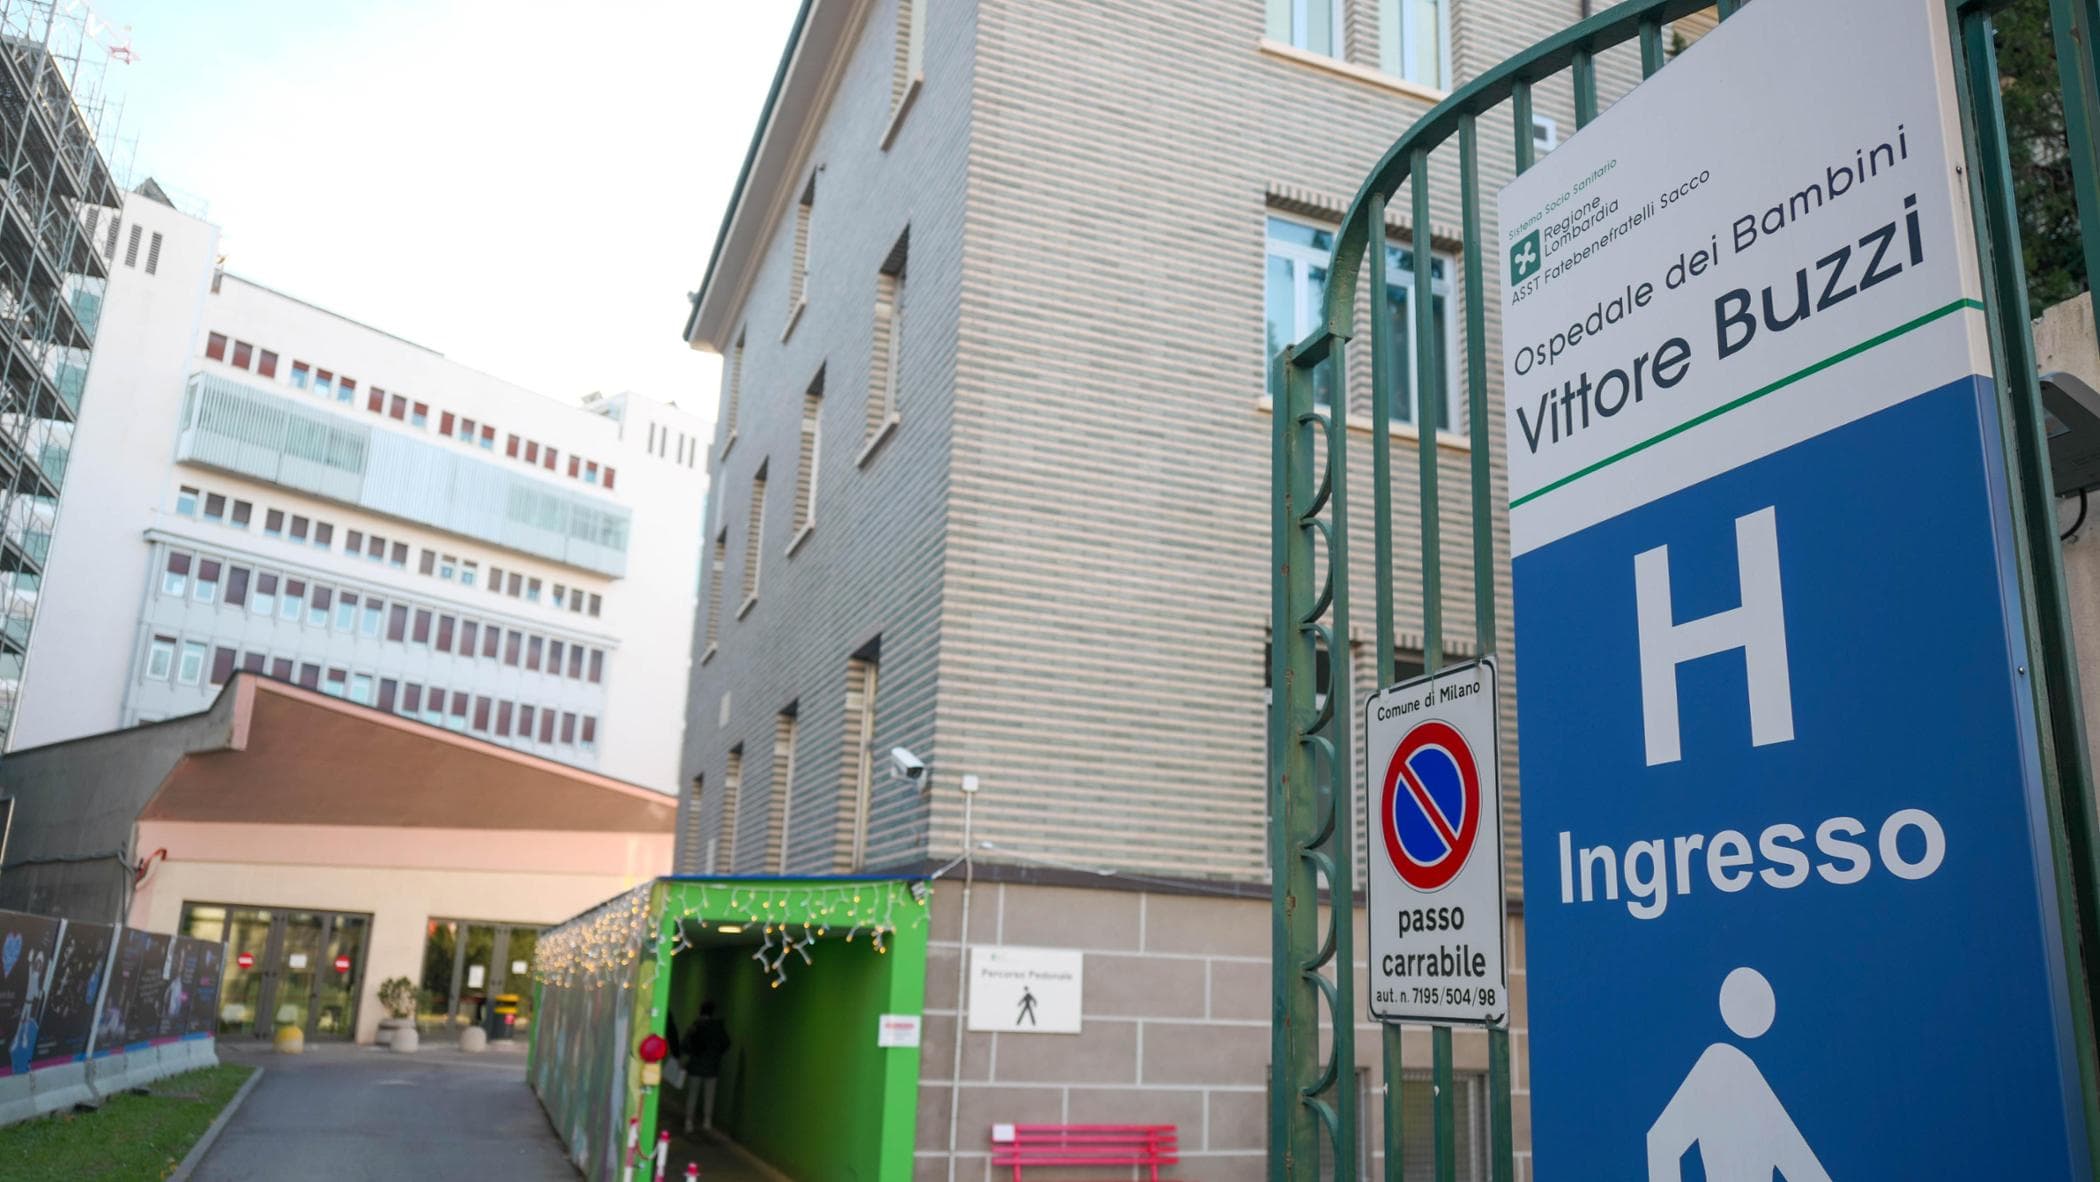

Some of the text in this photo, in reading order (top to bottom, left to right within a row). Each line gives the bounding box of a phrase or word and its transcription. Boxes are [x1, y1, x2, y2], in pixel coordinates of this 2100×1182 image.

[1508, 158, 1618, 241] Sistema Socio Sanitario
[1543, 196, 1601, 242] Regione
[1544, 199, 1619, 257] Lombardia
[1511, 170, 1710, 306] ASST Fatebenefratelli Sacco
[1514, 124, 1909, 376] Ospedale dei Bambini
[1516, 192, 1925, 455] Vittore Buzzi
[1633, 504, 1796, 768] H
[1377, 681, 1480, 721] Comune di Milano
[1558, 808, 1947, 921] Ingresso
[1398, 905, 1465, 938] passo
[1382, 944, 1487, 977] carrabile
[1376, 985, 1496, 1008] aut. n. 7195/504/98
